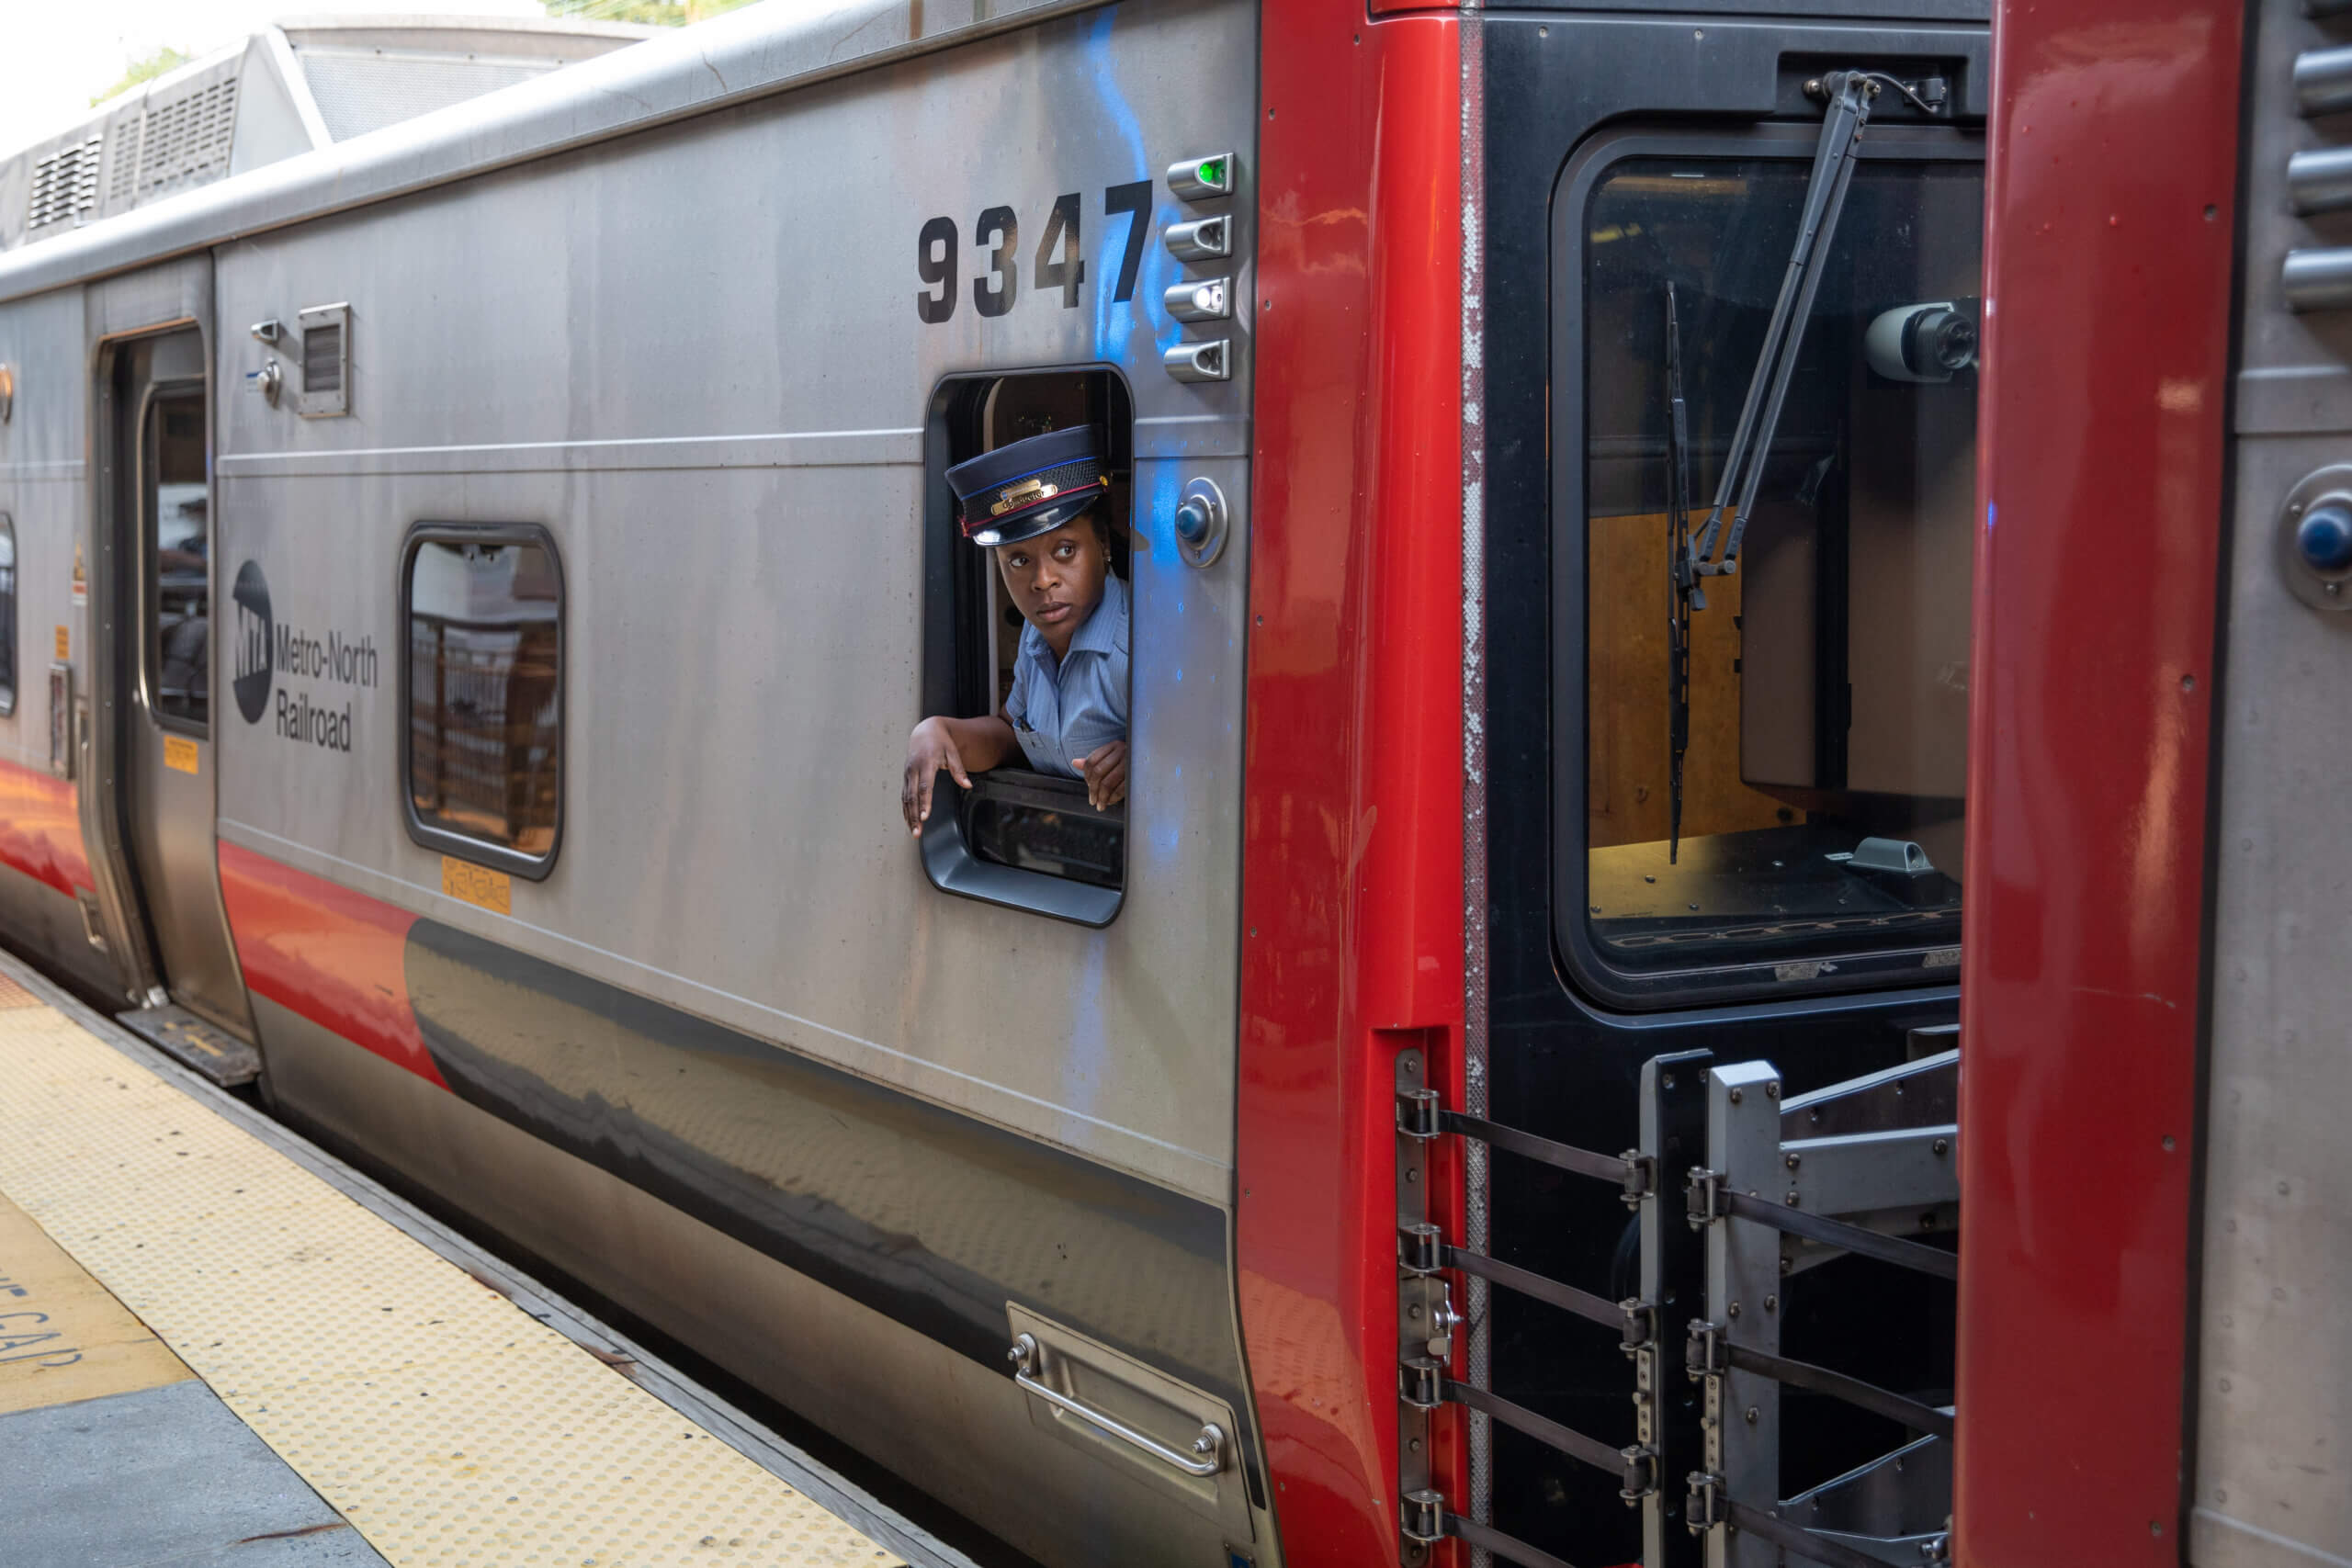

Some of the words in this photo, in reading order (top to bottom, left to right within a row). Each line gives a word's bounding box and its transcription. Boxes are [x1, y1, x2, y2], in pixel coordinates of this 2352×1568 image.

[917, 179, 1153, 324] 9347
[1002, 491, 1045, 509] Couctor
[232, 598, 268, 681] MTA
[277, 624, 378, 689] Metro-North
[277, 688, 352, 753] Railroad
